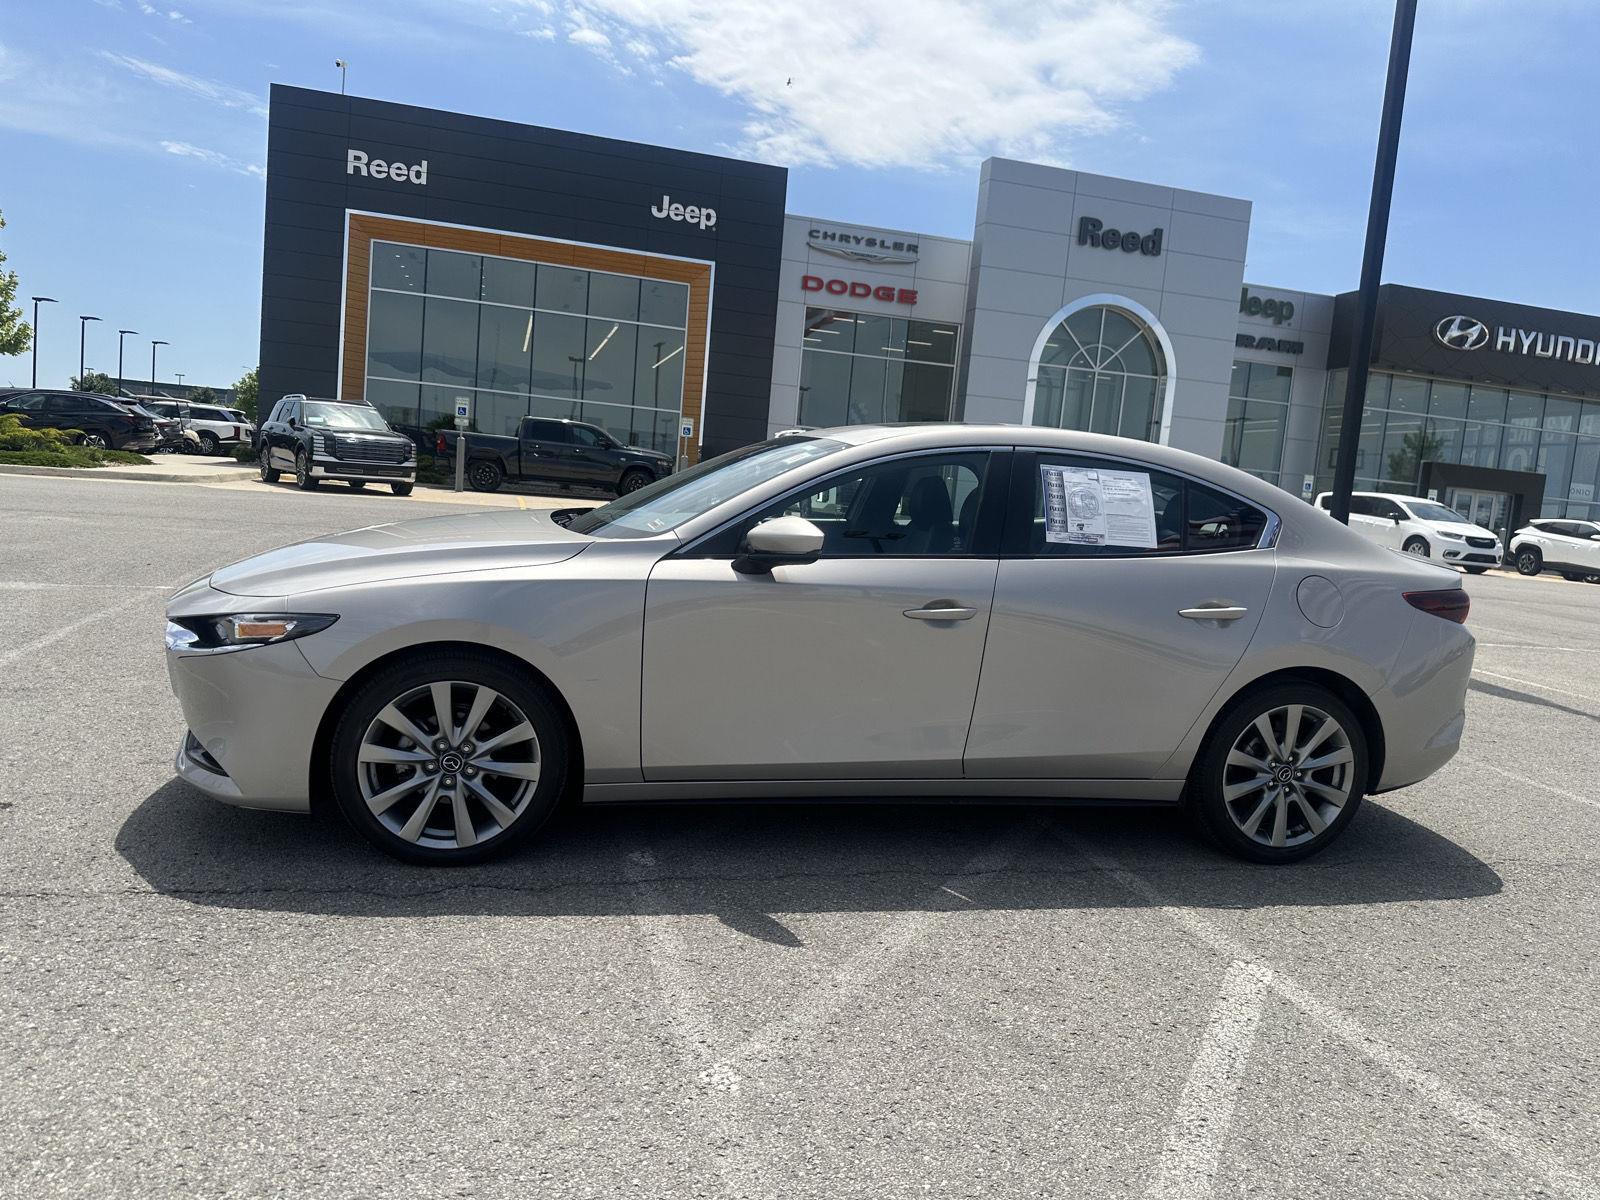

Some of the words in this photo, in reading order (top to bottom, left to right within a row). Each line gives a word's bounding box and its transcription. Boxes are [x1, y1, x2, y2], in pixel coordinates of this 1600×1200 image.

[346, 149, 428, 186] Reed
[651, 195, 717, 230] Jeep
[808, 229, 919, 254] CHRYSLER
[1078, 216, 1164, 257] Reed
[801, 275, 918, 305] DODGE
[1235, 333, 1304, 354] RAM
[1496, 326, 1600, 367] HYUND
